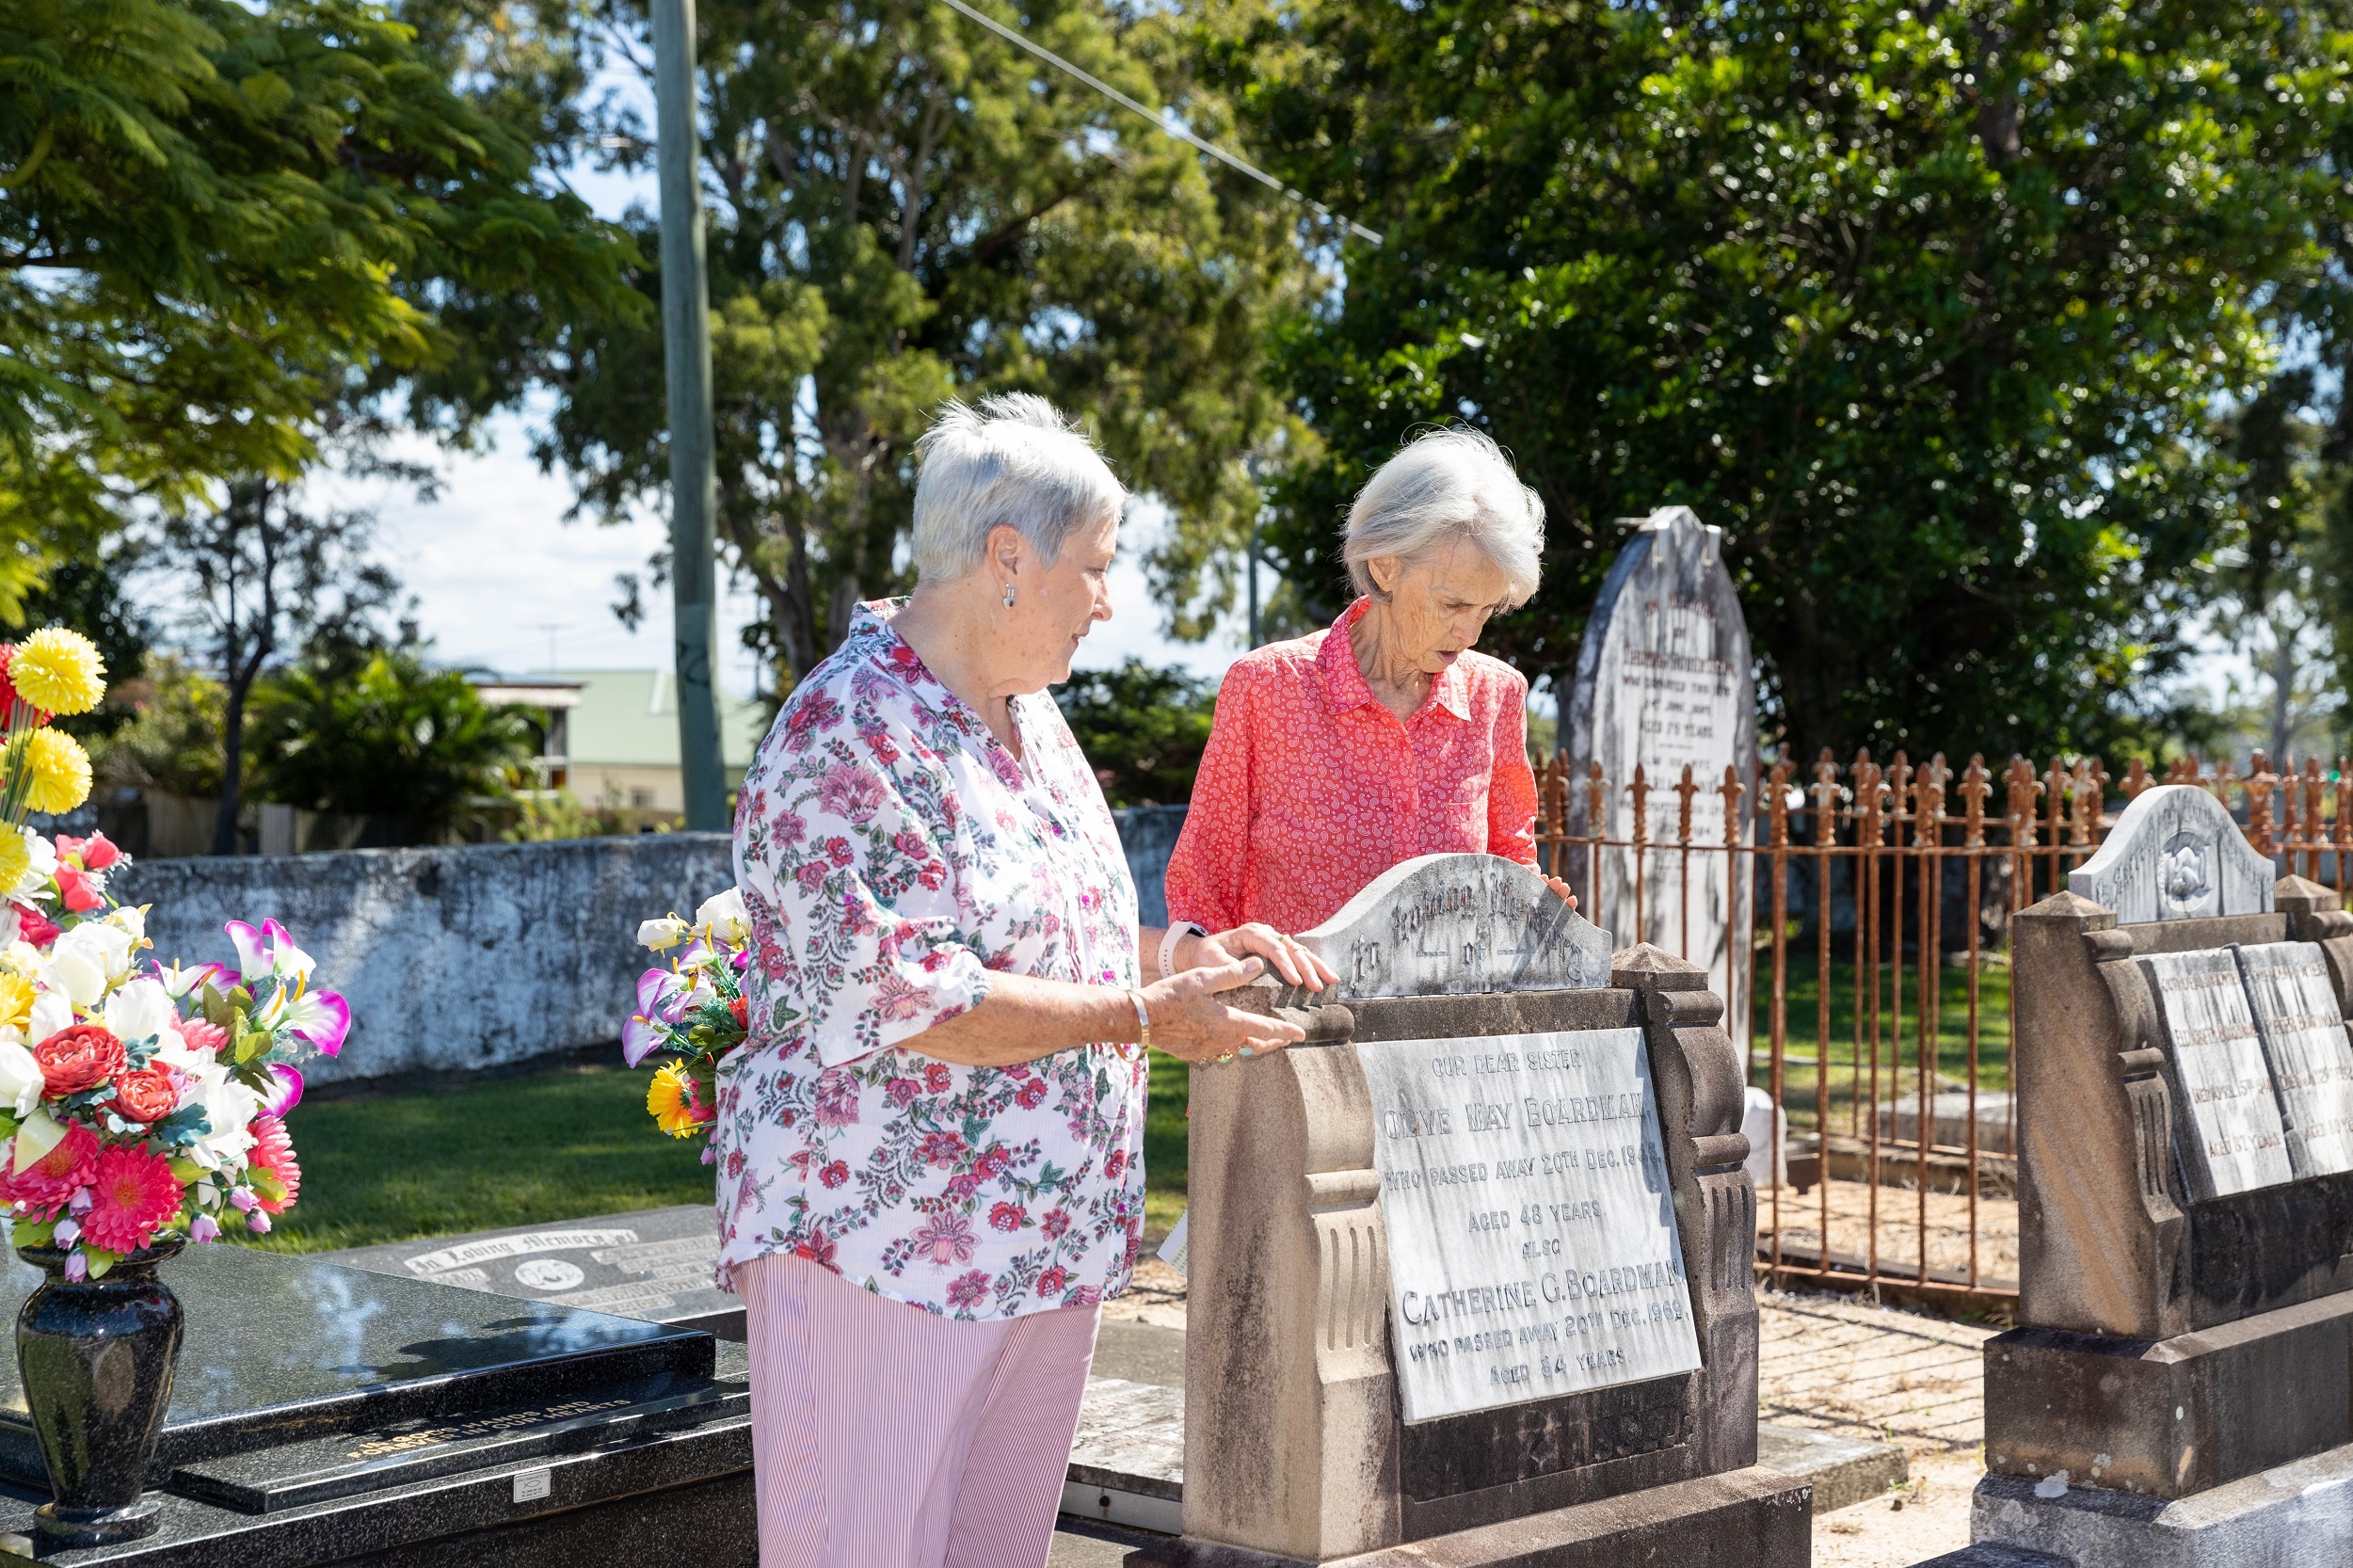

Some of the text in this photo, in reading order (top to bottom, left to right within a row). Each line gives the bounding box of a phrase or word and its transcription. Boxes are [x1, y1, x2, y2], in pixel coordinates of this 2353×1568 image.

[1432, 1048, 1582, 1077] OUR DEAR SISTER
[1384, 1108, 1452, 1139] OLIVE
[1465, 1102, 1513, 1131] MAY
[1384, 1170, 1421, 1191] WHO
[1429, 1162, 1488, 1187] PASSED
[1496, 1158, 1535, 1179] AWAY
[1541, 1149, 1579, 1176] 20TH
[1468, 1210, 1511, 1233] AGED
[1520, 1203, 1543, 1225] 48
[1522, 1238, 1561, 1259] ALSO
[1402, 1281, 1537, 1327] CATHERINE
[1409, 1339, 1449, 1363] WHO
[1453, 1329, 1513, 1355] PASSED
[1519, 1321, 1559, 1345] AWAY
[1564, 1311, 1605, 1337] 20TH
[1490, 1364, 1529, 1386] AGED
[1540, 1354, 1567, 1377] 84
[346, 1399, 632, 1459] FOREVER IN OUR HEARTS
[460, 1411, 541, 1431] HANDS
[545, 1400, 591, 1413] AND
